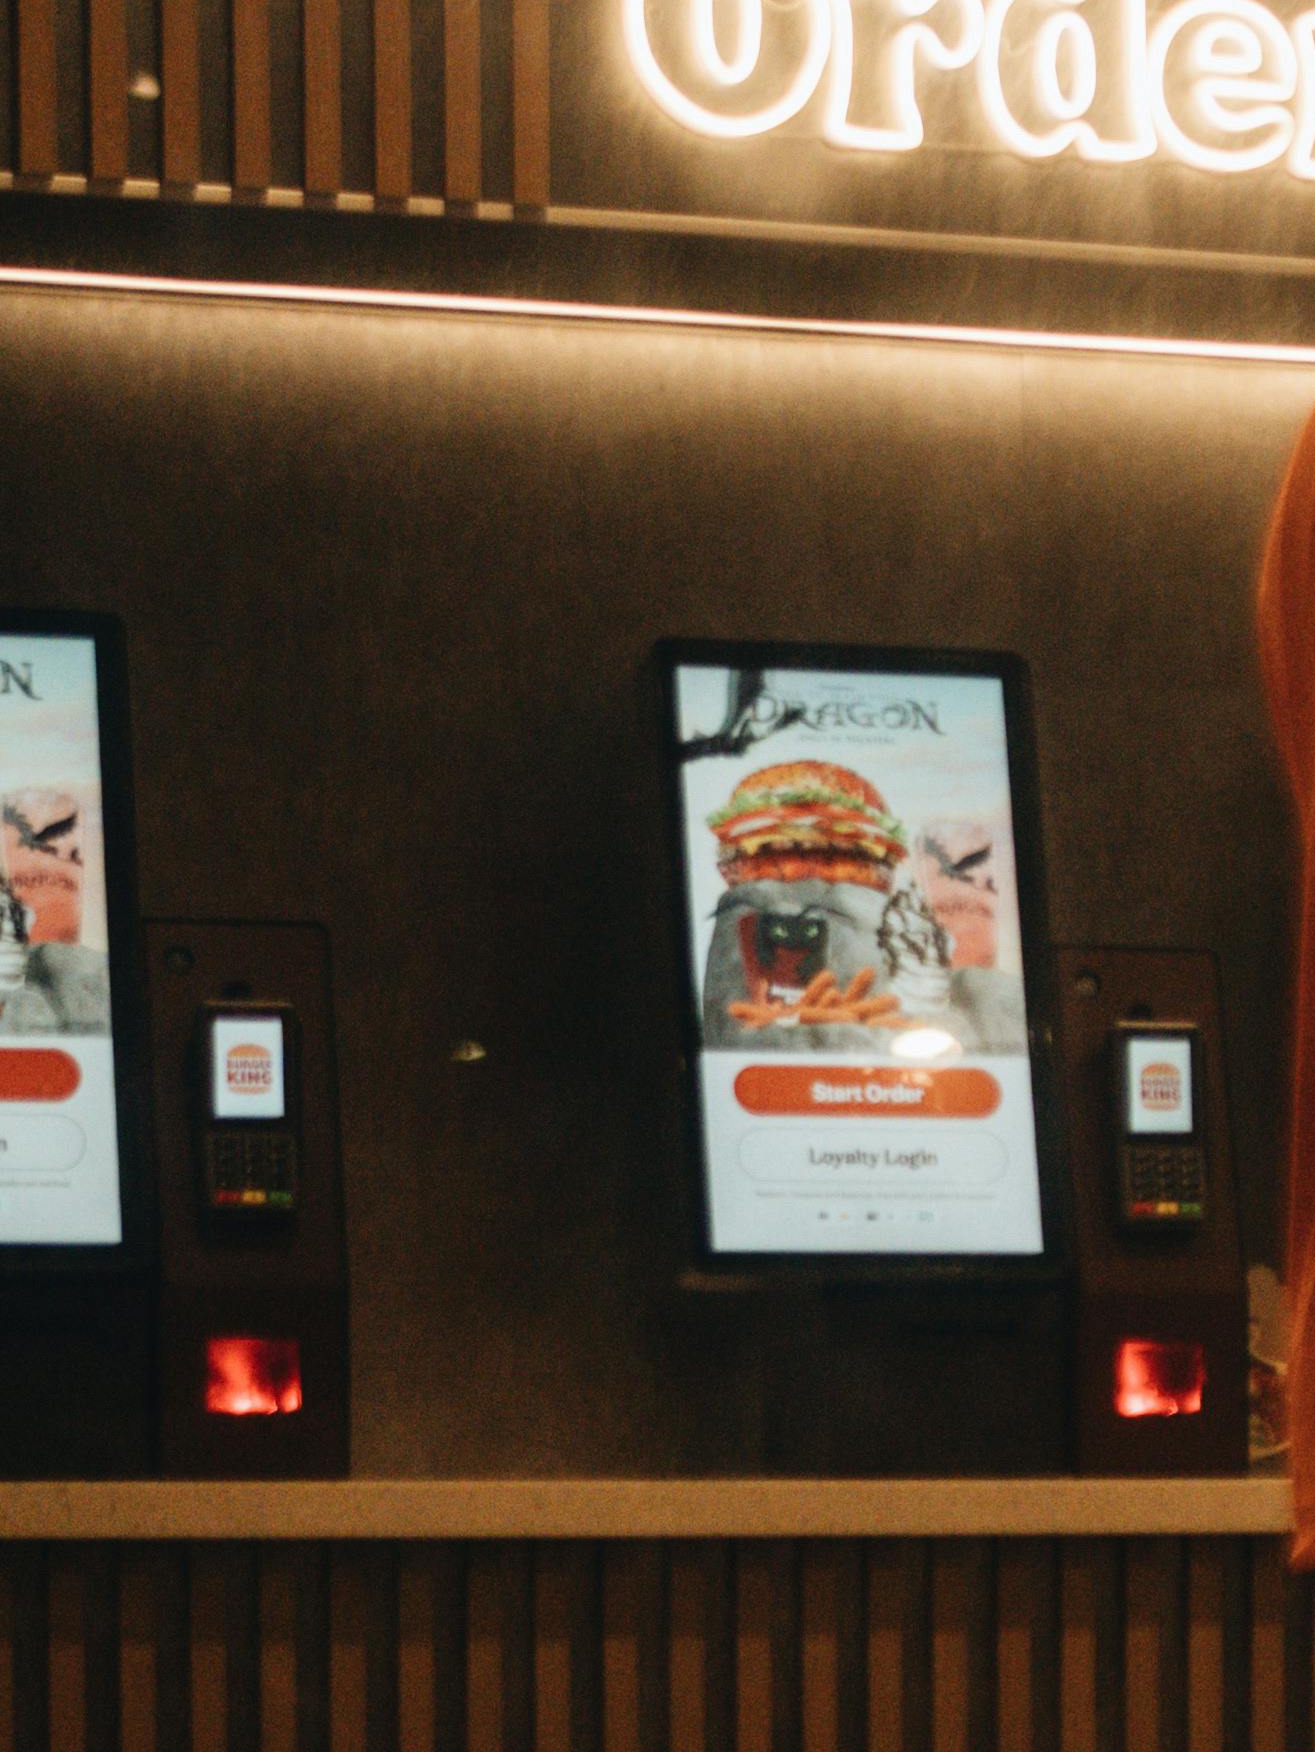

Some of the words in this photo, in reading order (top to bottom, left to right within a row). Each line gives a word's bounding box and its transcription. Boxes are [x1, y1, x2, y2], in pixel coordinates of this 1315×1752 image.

[226, 1070, 272, 1085] KING
[811, 1081, 861, 1103] Start
[866, 1084, 924, 1104] Order
[1141, 1087, 1181, 1100] KING
[808, 1148, 879, 1171] Loyalty
[885, 1150, 938, 1171] Login
